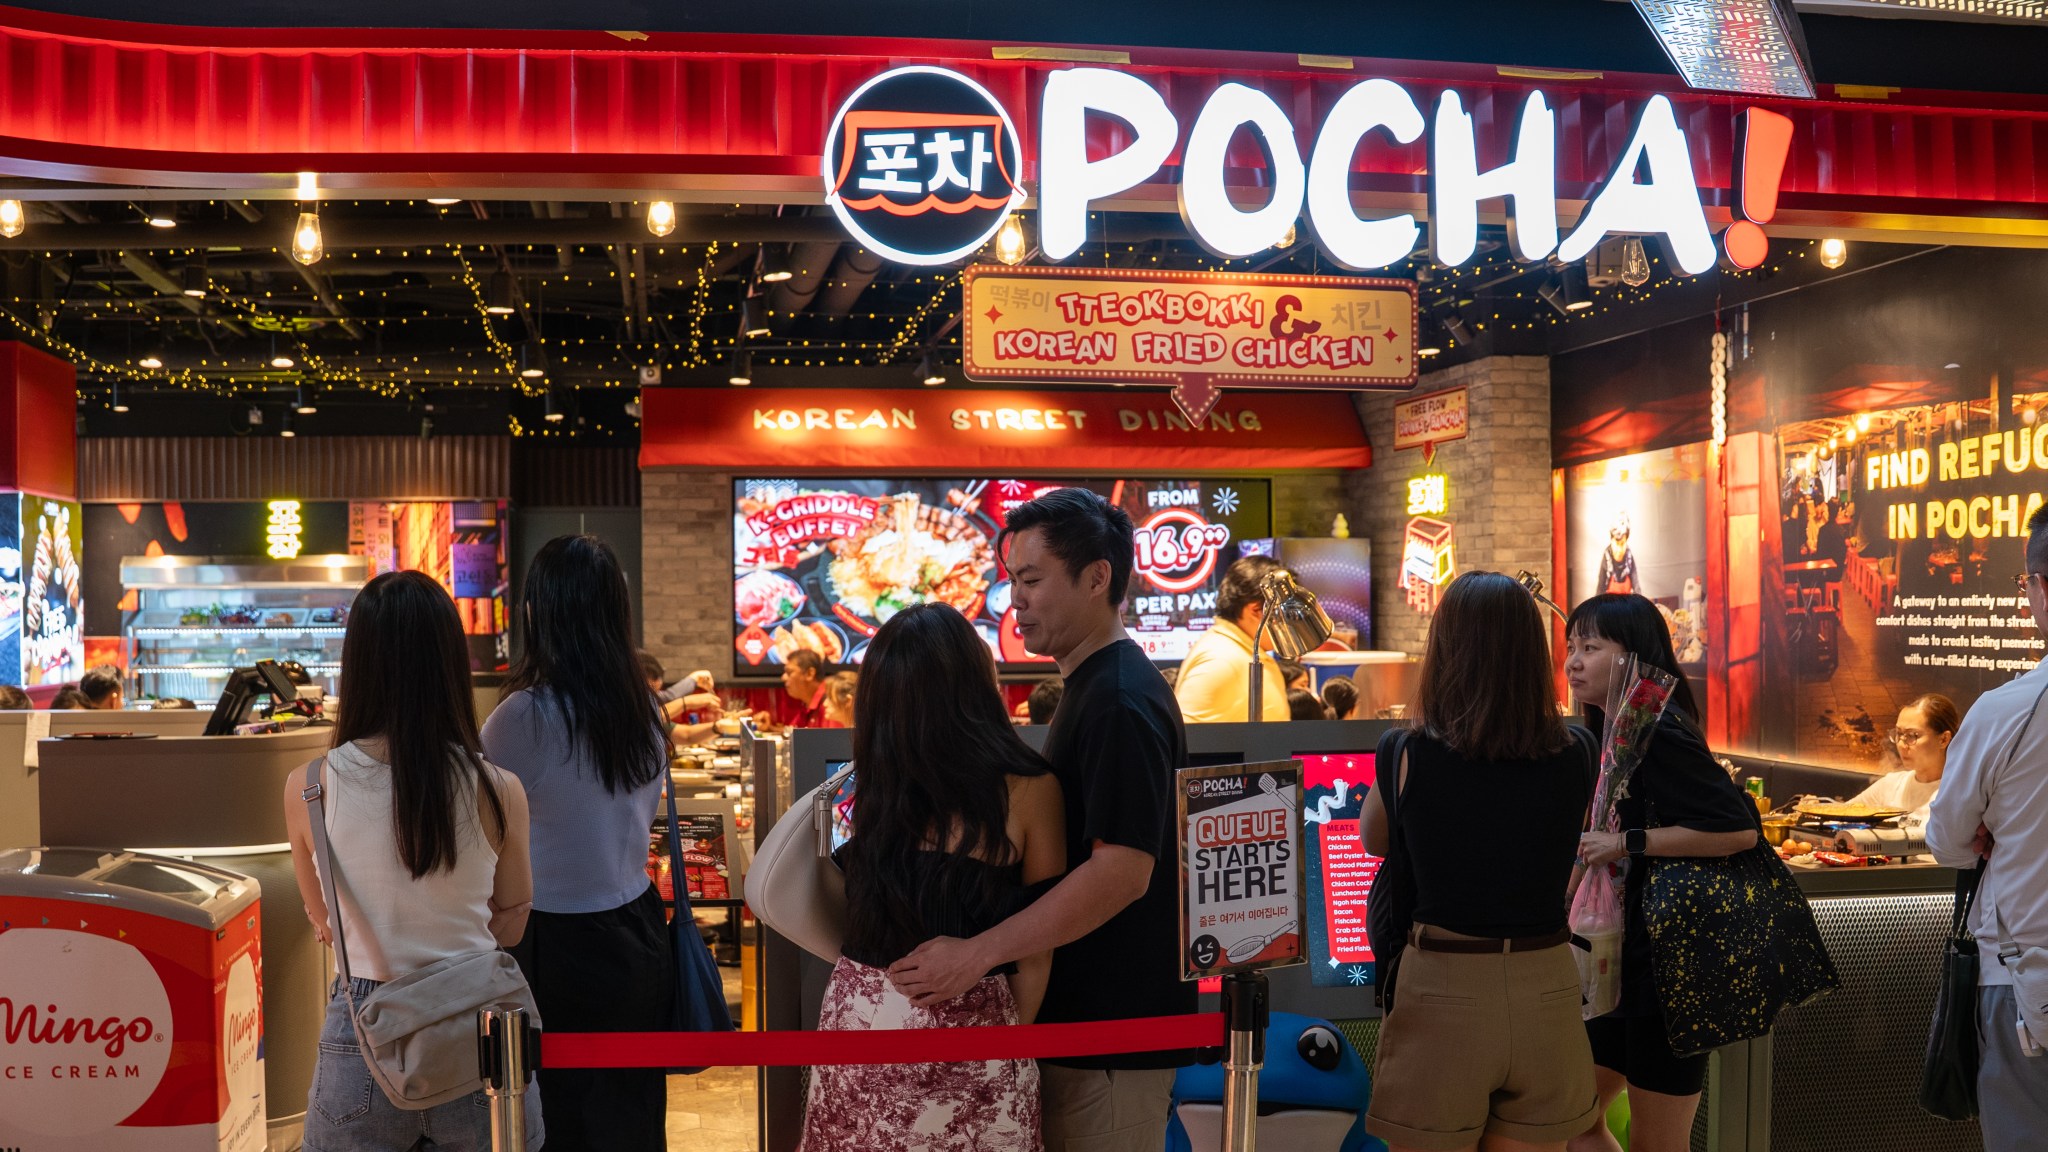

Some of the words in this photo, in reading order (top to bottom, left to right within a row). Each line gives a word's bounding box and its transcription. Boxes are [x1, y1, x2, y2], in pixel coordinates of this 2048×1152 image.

[859, 132, 992, 194] 포차
[1039, 67, 1794, 275] POCHA!
[990, 284, 1050, 312] 떡볶이
[1057, 290, 1264, 330] TTEOKBOKKI
[1270, 295, 1321, 341] &
[1331, 300, 1381, 331] 치킨
[995, 329, 1116, 364] KOREAN
[1133, 332, 1227, 364] FRIED
[1233, 335, 1374, 370] CHICKEN
[754, 408, 917, 430] KOREAN
[952, 408, 1087, 430] STREET
[1118, 409, 1262, 432] DINNG
[1410, 402, 1426, 416] FREE
[1428, 398, 1447, 412] FLOW
[1867, 448, 1930, 490] FIND
[1148, 489, 1199, 507] FROM
[747, 495, 880, 536] K-GRIDDLE
[1888, 503, 1917, 539] IN
[771, 517, 862, 547] BUFFET
[1136, 595, 1173, 614] PER
[1178, 591, 1219, 611] PAX
[1893, 595, 1901, 607] A
[1902, 595, 1936, 610] gateway
[1937, 595, 1947, 607] to
[1948, 598, 1960, 607] an
[1961, 594, 1995, 610] entirely
[1996, 597, 2016, 607] new
[1876, 615, 1905, 626] comfort
[1907, 614, 1931, 626] dishes
[1933, 614, 1966, 629] straight
[1967, 615, 1989, 627] from
[1989, 614, 2005, 627] the
[2006, 615, 2038, 628] street
[1908, 634, 1930, 646] made
[1931, 634, 1941, 646] to
[1942, 635, 1970, 647] create
[1970, 634, 2000, 650] lasting
[2001, 636, 2046, 649] memories
[1904, 653, 1922, 665] with
[1923, 657, 1930, 665] a
[1931, 654, 1967, 667] fun-filled
[1968, 655, 1995, 671] dining
[1995, 657, 2040, 672] experien
[1203, 776, 1248, 793] POCHA!
[1197, 809, 1286, 846] QUEUE
[1326, 824, 1355, 832] MEATS
[685, 855, 711, 863] FLOW
[1195, 840, 1290, 871] STARTS
[1198, 863, 1287, 904] HERE
[1219, 910, 1245, 924] 여기서
[228, 1008, 256, 1064] Mingo
[5, 1066, 33, 1079] CE
[51, 1065, 140, 1079] CREAM
